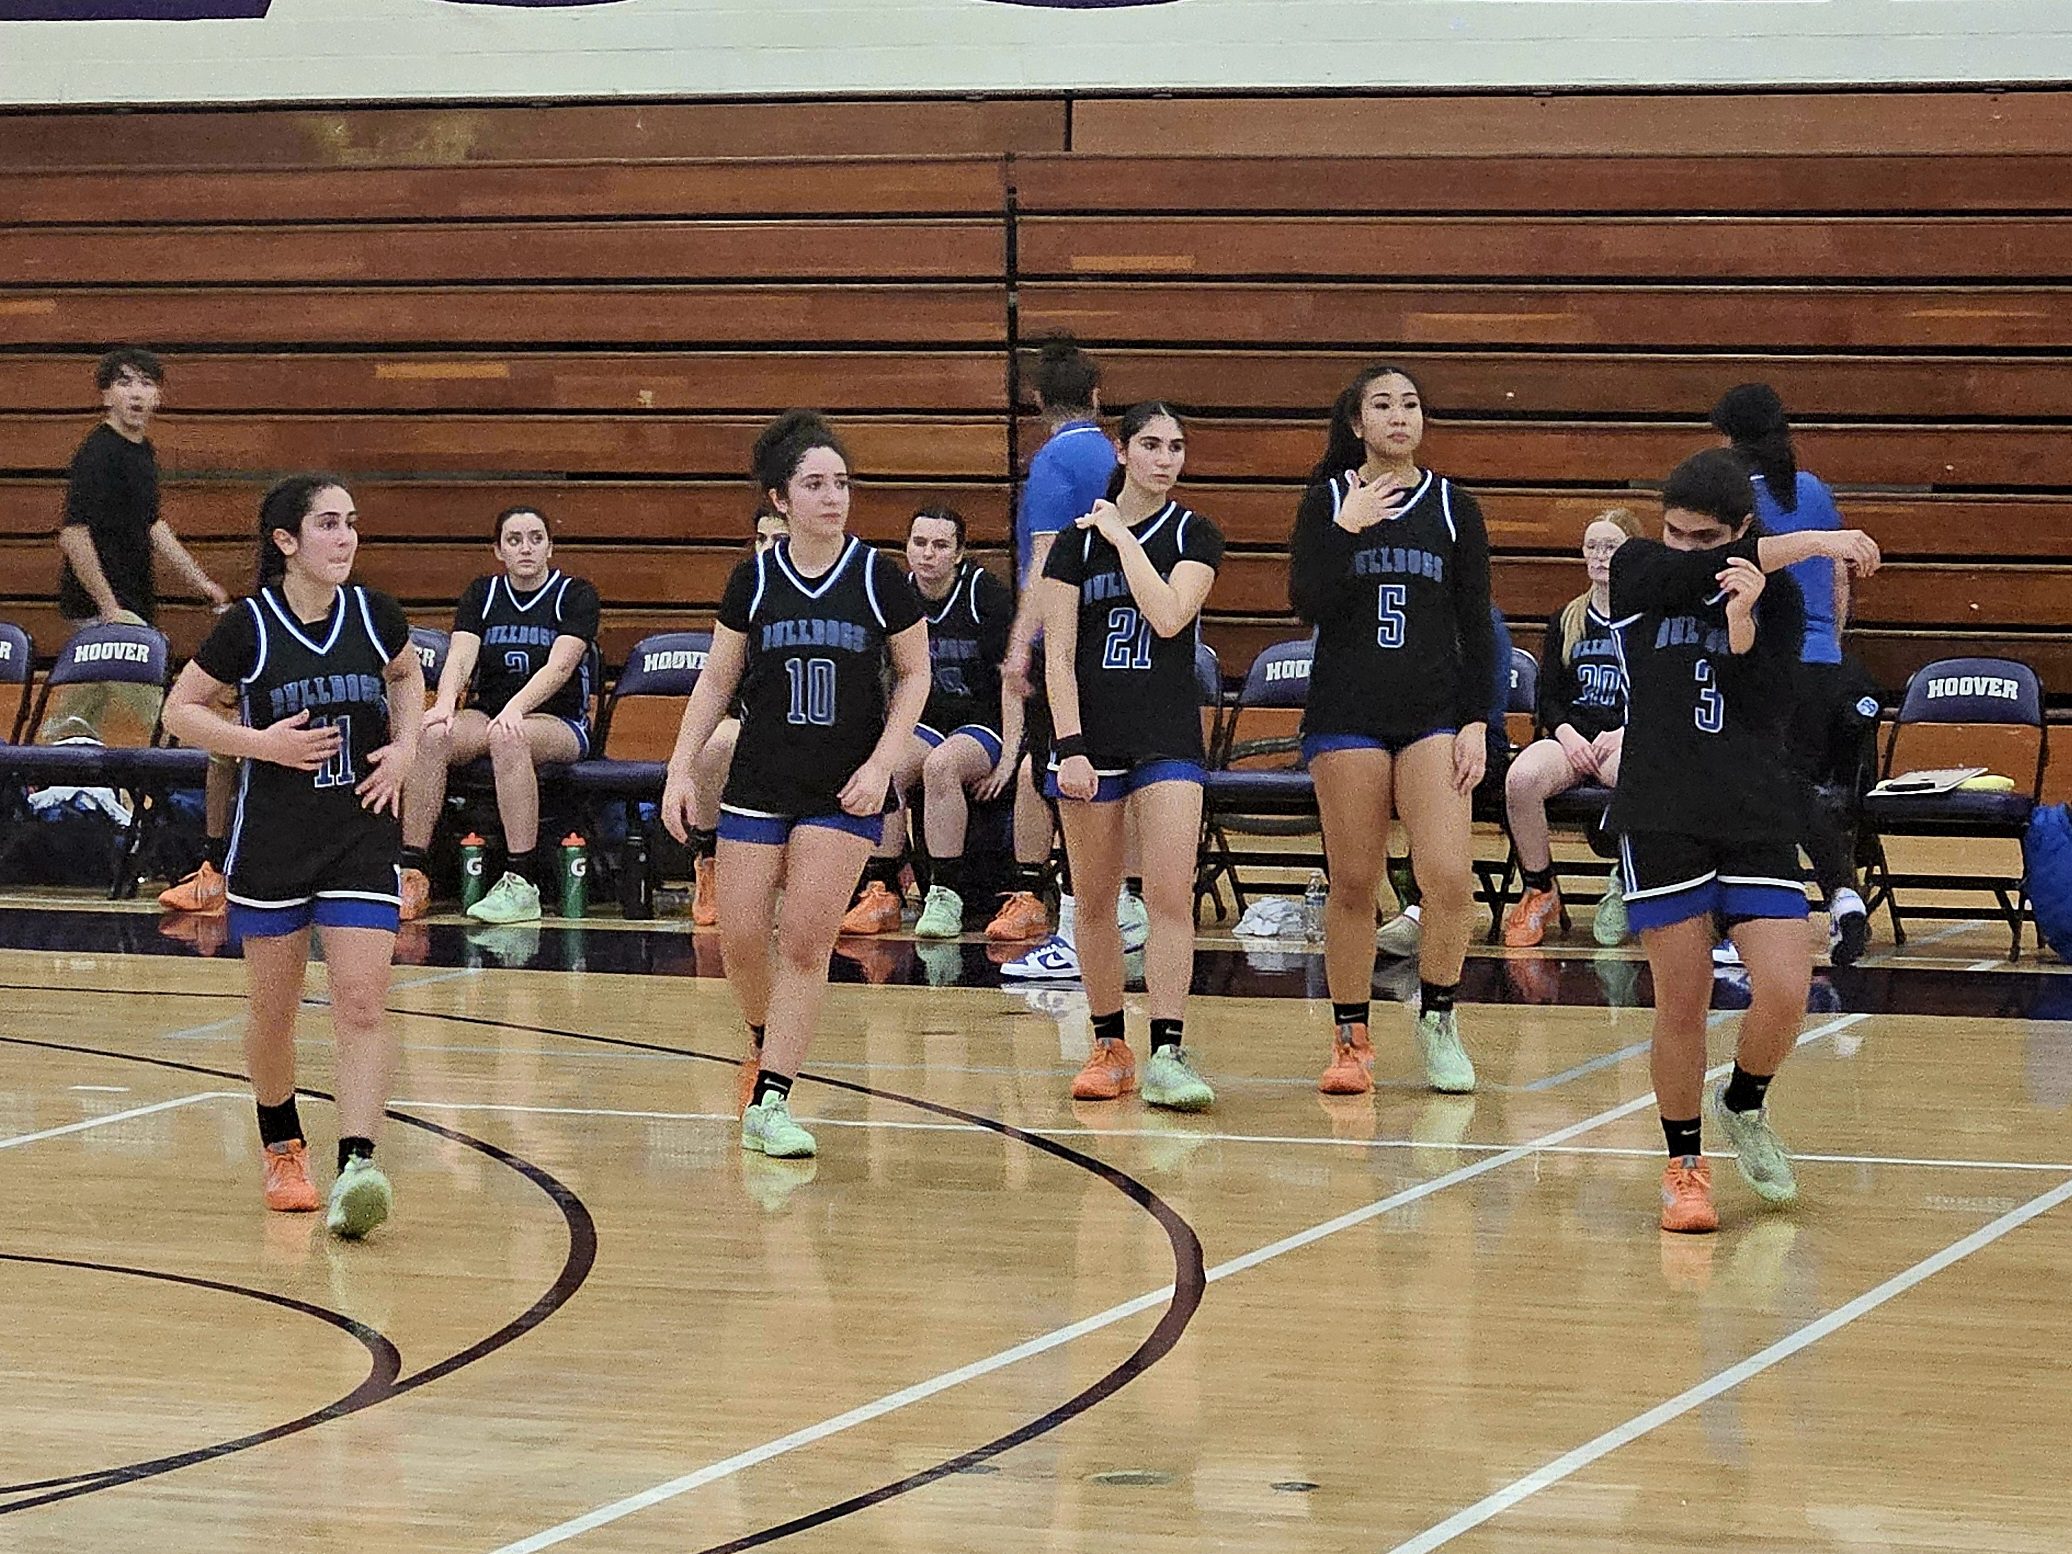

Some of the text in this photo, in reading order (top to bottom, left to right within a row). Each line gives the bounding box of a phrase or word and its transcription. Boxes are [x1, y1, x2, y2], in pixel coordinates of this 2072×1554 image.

[1102, 606, 1152, 670] 21
[1377, 584, 1406, 648] 5
[73, 642, 150, 664] HOOVER
[1265, 659, 1313, 682] HOO
[784, 657, 837, 727] 10
[1694, 658, 1725, 734] 3
[1927, 676, 2019, 701] HOOVER
[310, 714, 356, 789] 11
[466, 856, 483, 876] G
[570, 857, 587, 877] G
